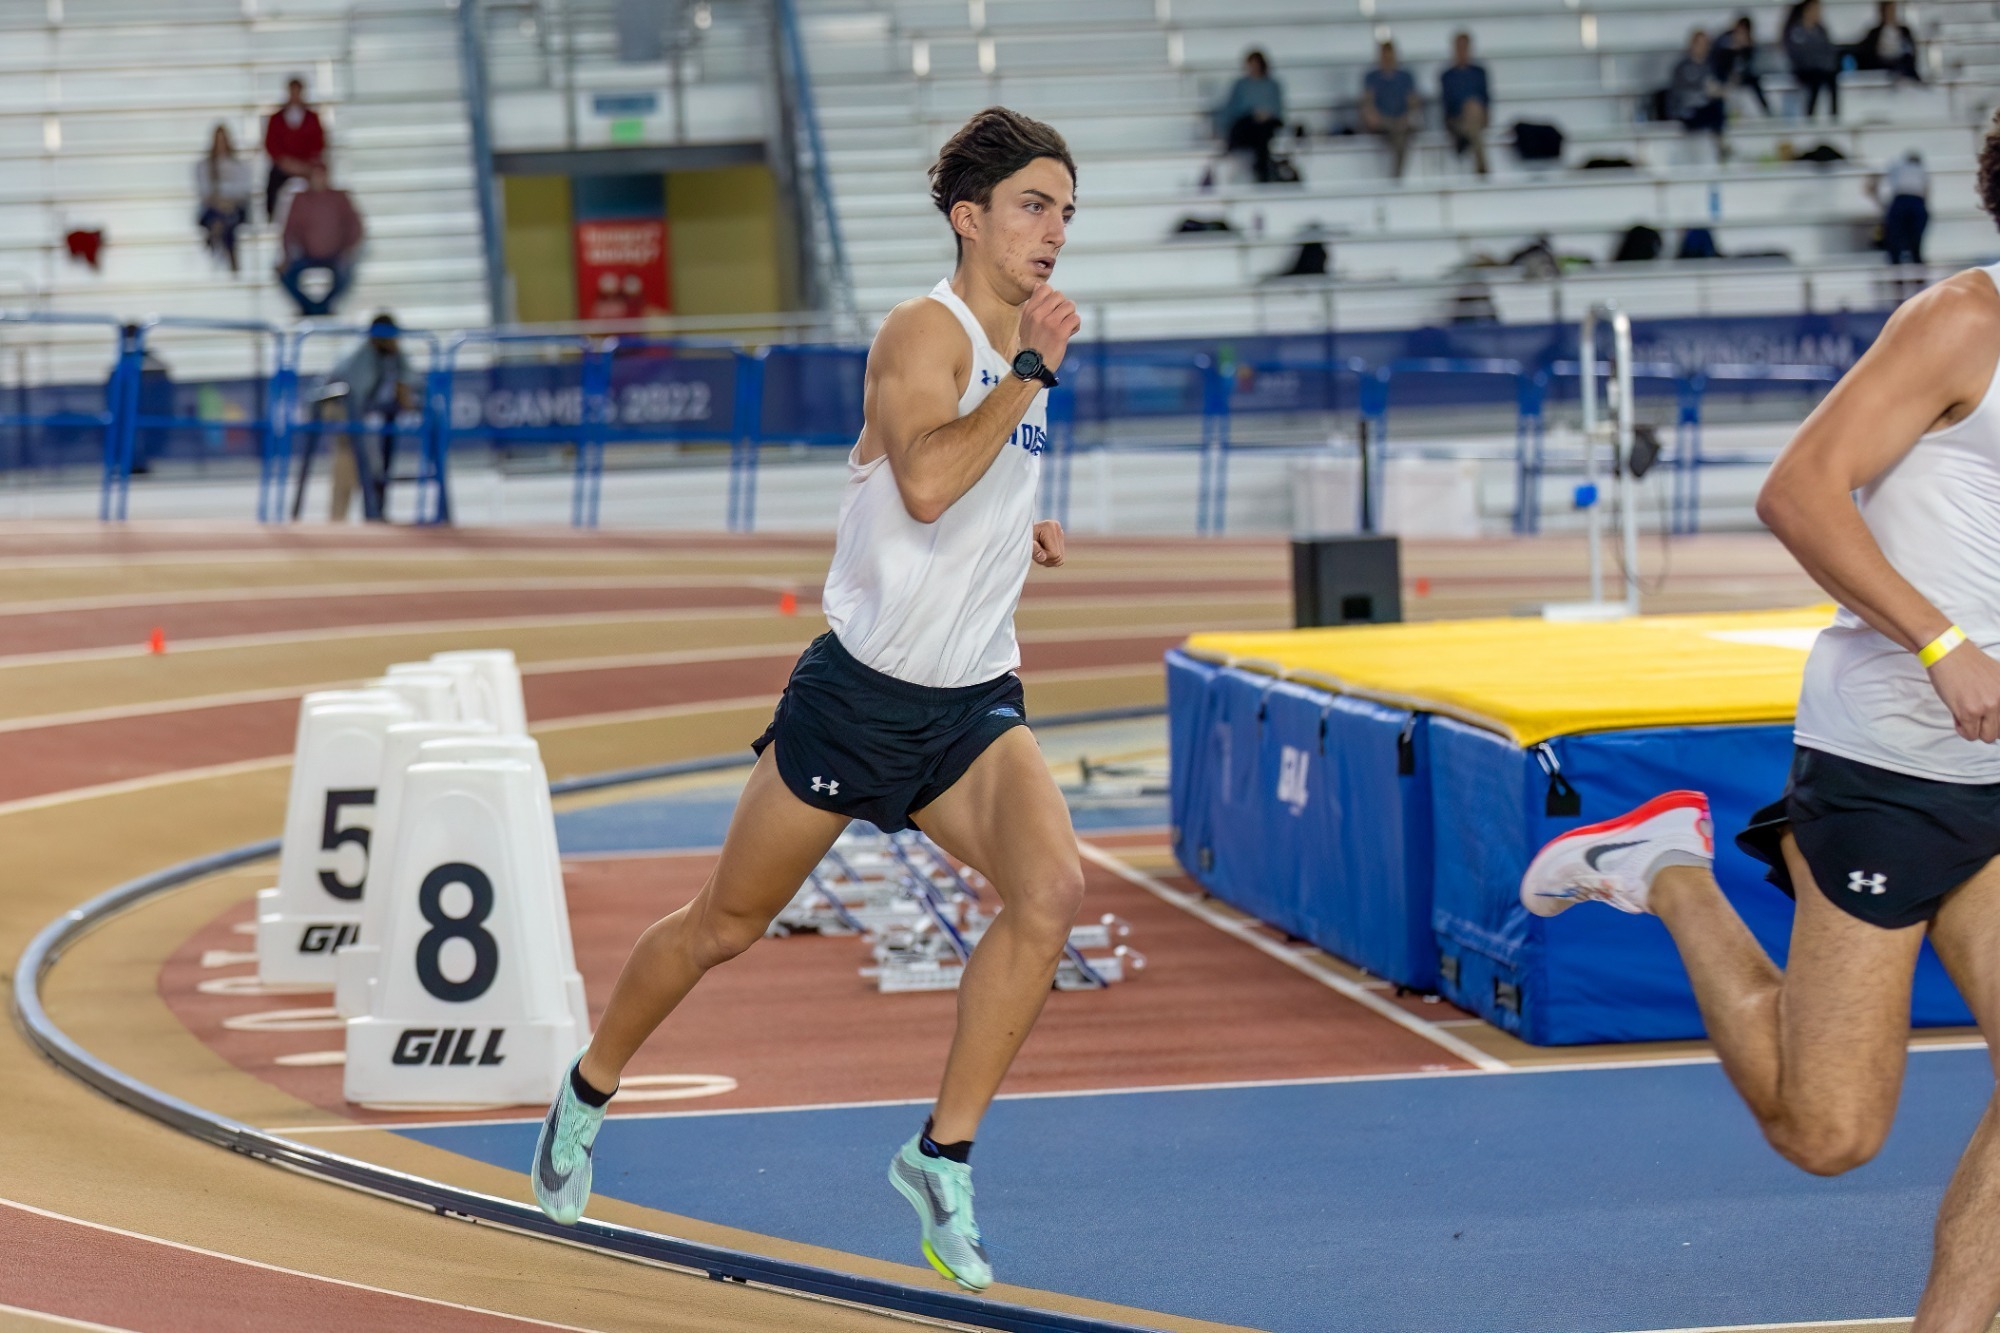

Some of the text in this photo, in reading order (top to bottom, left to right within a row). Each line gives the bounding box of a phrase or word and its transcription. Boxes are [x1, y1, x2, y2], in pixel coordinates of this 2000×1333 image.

[621, 381, 712, 424] 2022
[316, 787, 378, 903] 5
[415, 861, 499, 1003] 8
[391, 1027, 507, 1067] GILL
